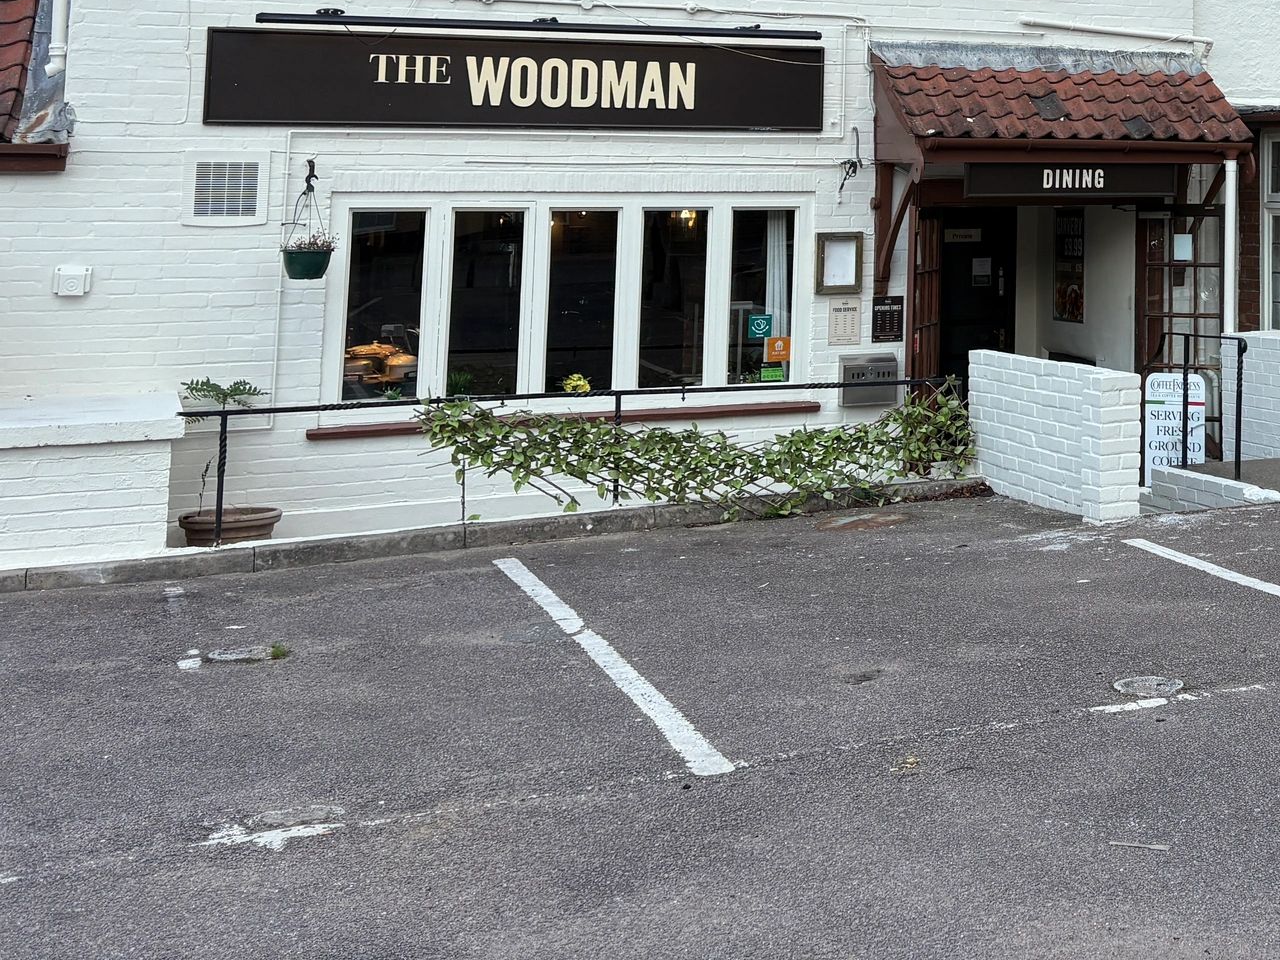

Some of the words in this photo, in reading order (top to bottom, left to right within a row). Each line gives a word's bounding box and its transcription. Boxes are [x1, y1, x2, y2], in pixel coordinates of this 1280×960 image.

[370, 54, 450, 85] THE
[466, 56, 696, 110] WOODMAN
[1042, 168, 1104, 189] DINING
[1064, 237, 1083, 257] £9.99
